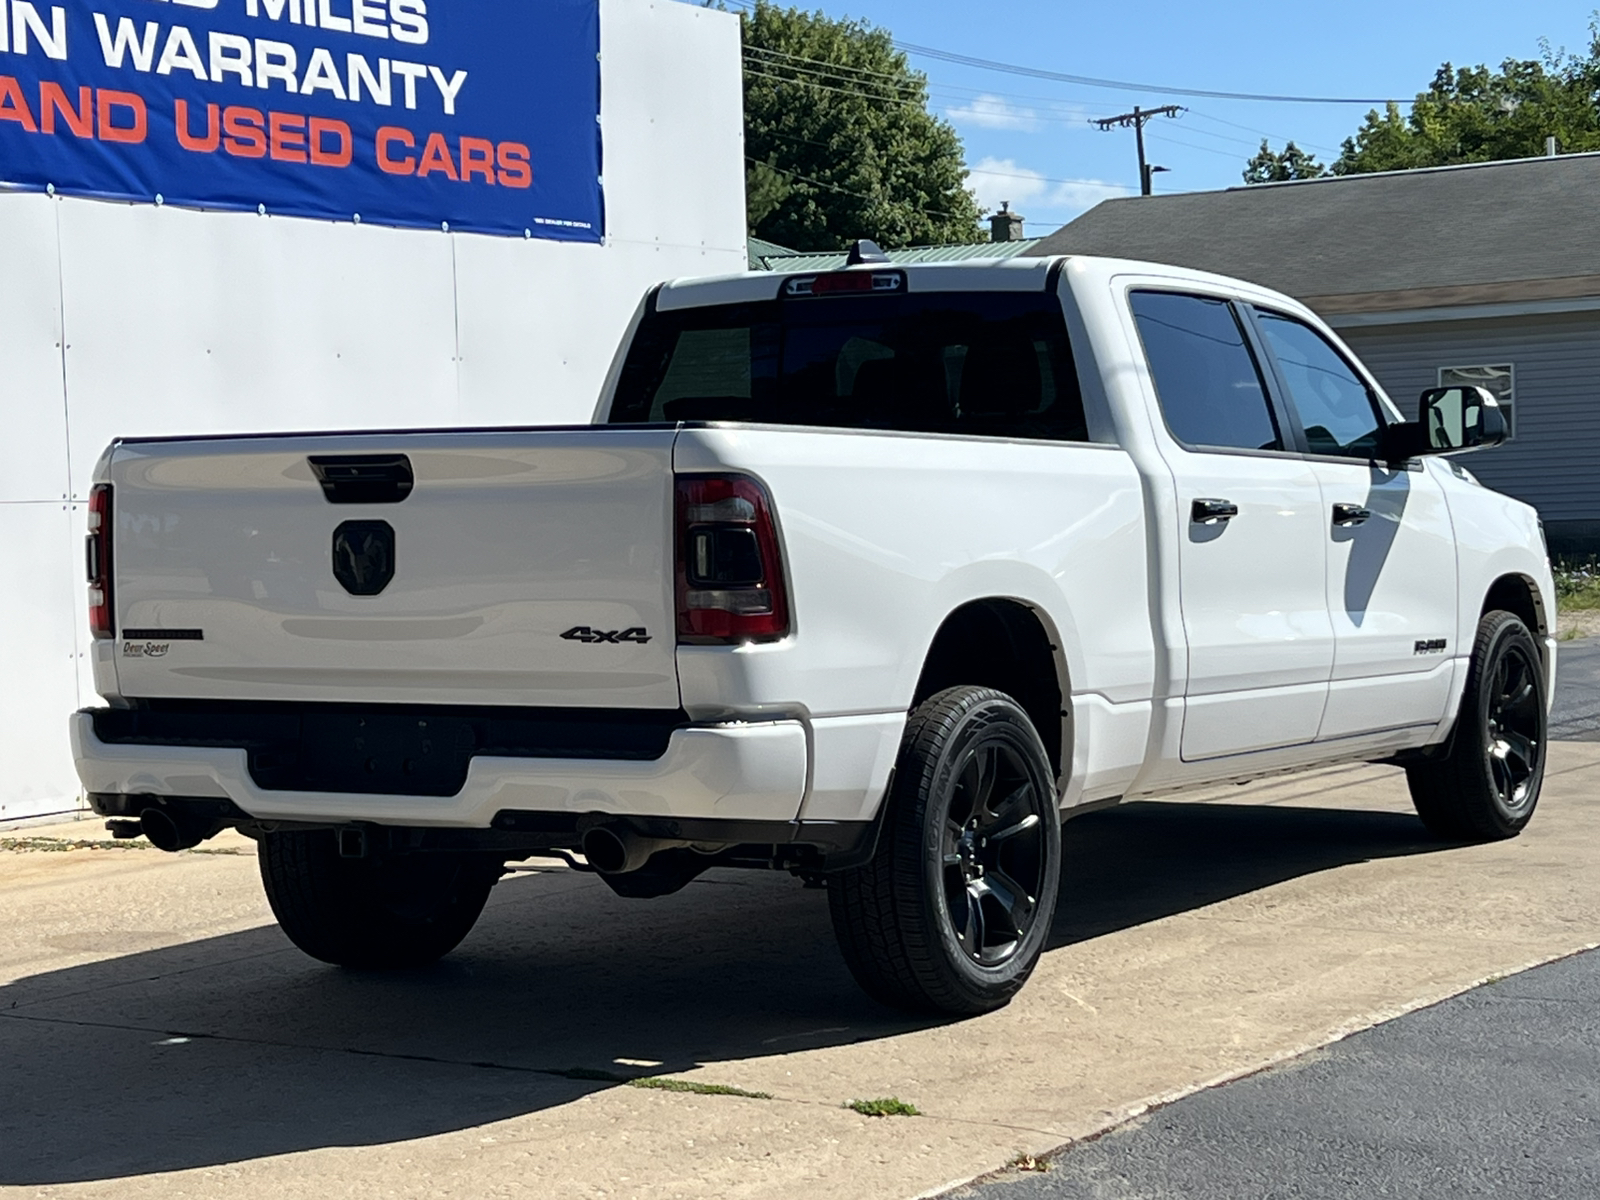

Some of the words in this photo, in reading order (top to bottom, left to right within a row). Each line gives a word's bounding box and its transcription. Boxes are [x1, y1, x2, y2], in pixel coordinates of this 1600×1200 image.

[93, 12, 468, 115] WARRANTY
[0, 75, 147, 144] AND
[174, 98, 353, 168] USED
[375, 126, 533, 189] CARS
